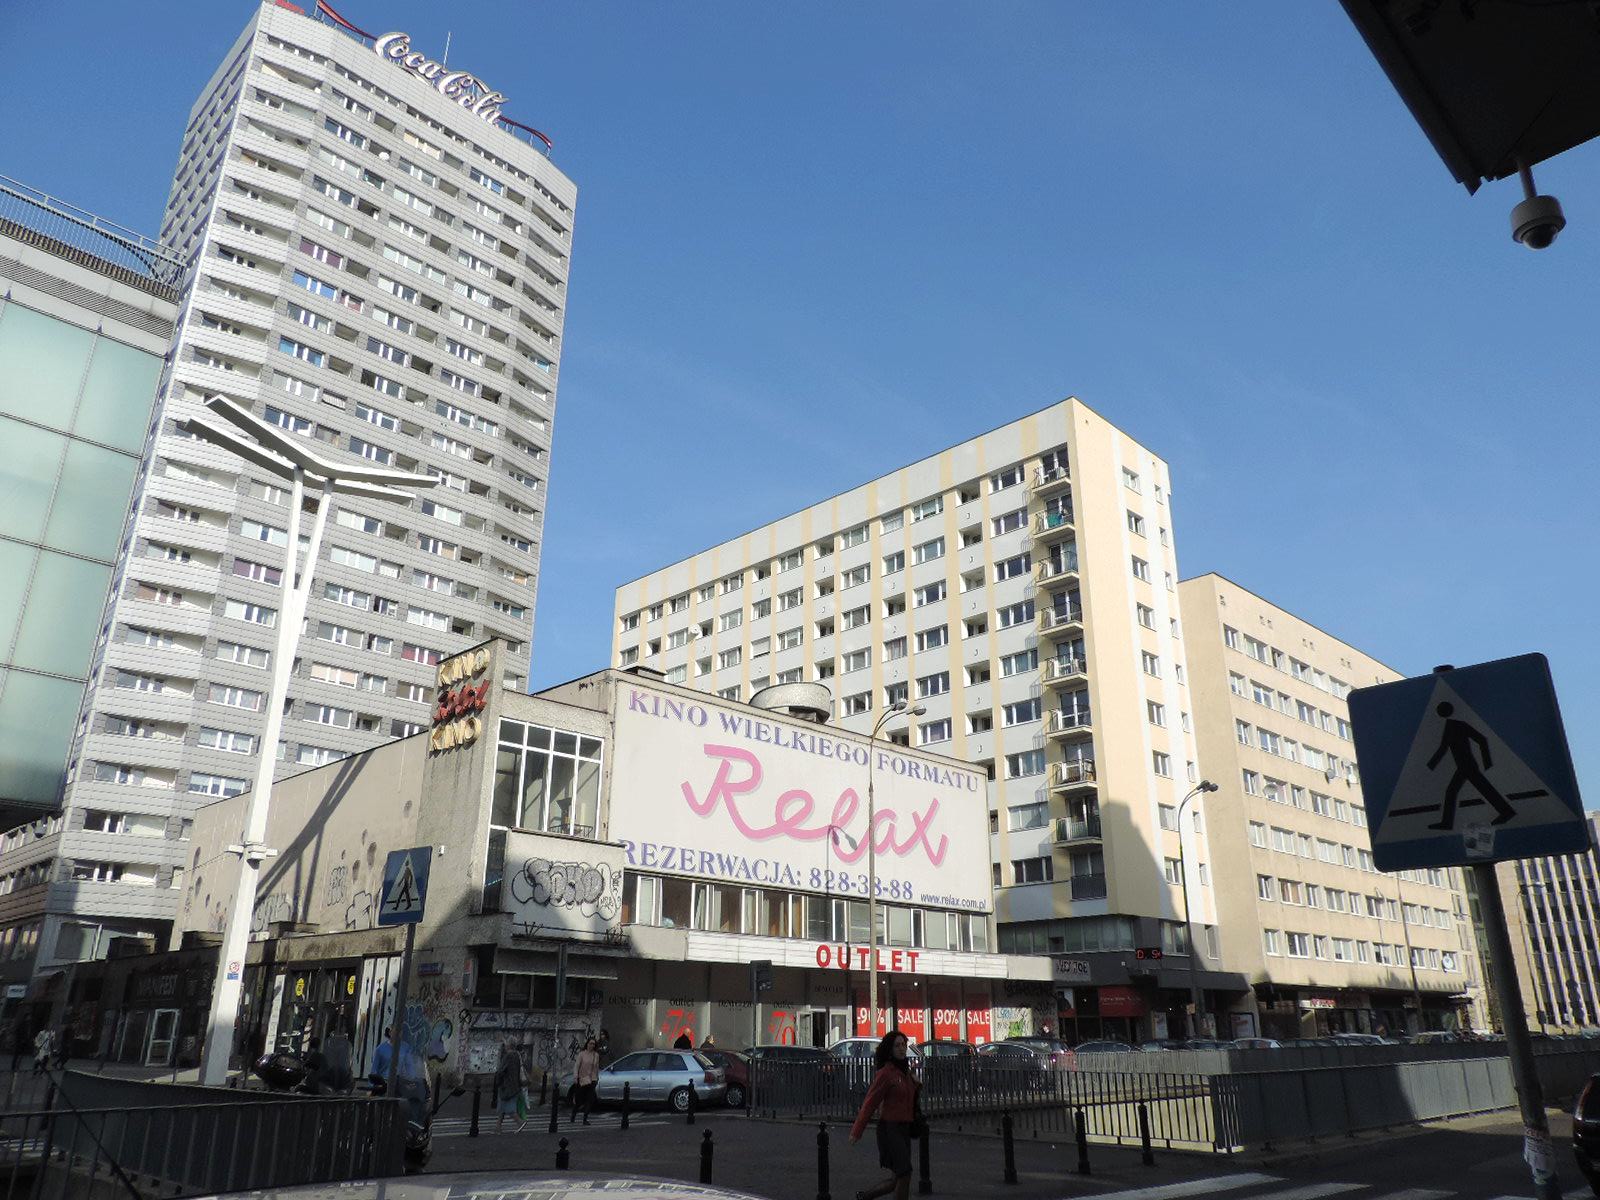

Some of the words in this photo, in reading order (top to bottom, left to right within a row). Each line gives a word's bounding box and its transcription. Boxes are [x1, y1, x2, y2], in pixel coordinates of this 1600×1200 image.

[374, 31, 509, 125] Coca-Cola
[437, 647, 491, 687] KINO
[429, 716, 482, 752] KINO
[628, 689, 709, 728] KINO
[718, 711, 869, 767] WIELKIEGO
[877, 751, 979, 793] FORMATU
[680, 742, 949, 870] Relax
[619, 839, 802, 887] REZERWACJA:
[809, 867, 914, 901] 828-38-88
[920, 892, 987, 909] www.relax.com.pl
[815, 943, 920, 973] OUTLET
[857, 1007, 885, 1025] -9%
[898, 1009, 924, 1025] SALE
[934, 1009, 960, 1025] -90%
[967, 1011, 990, 1025] SALE
